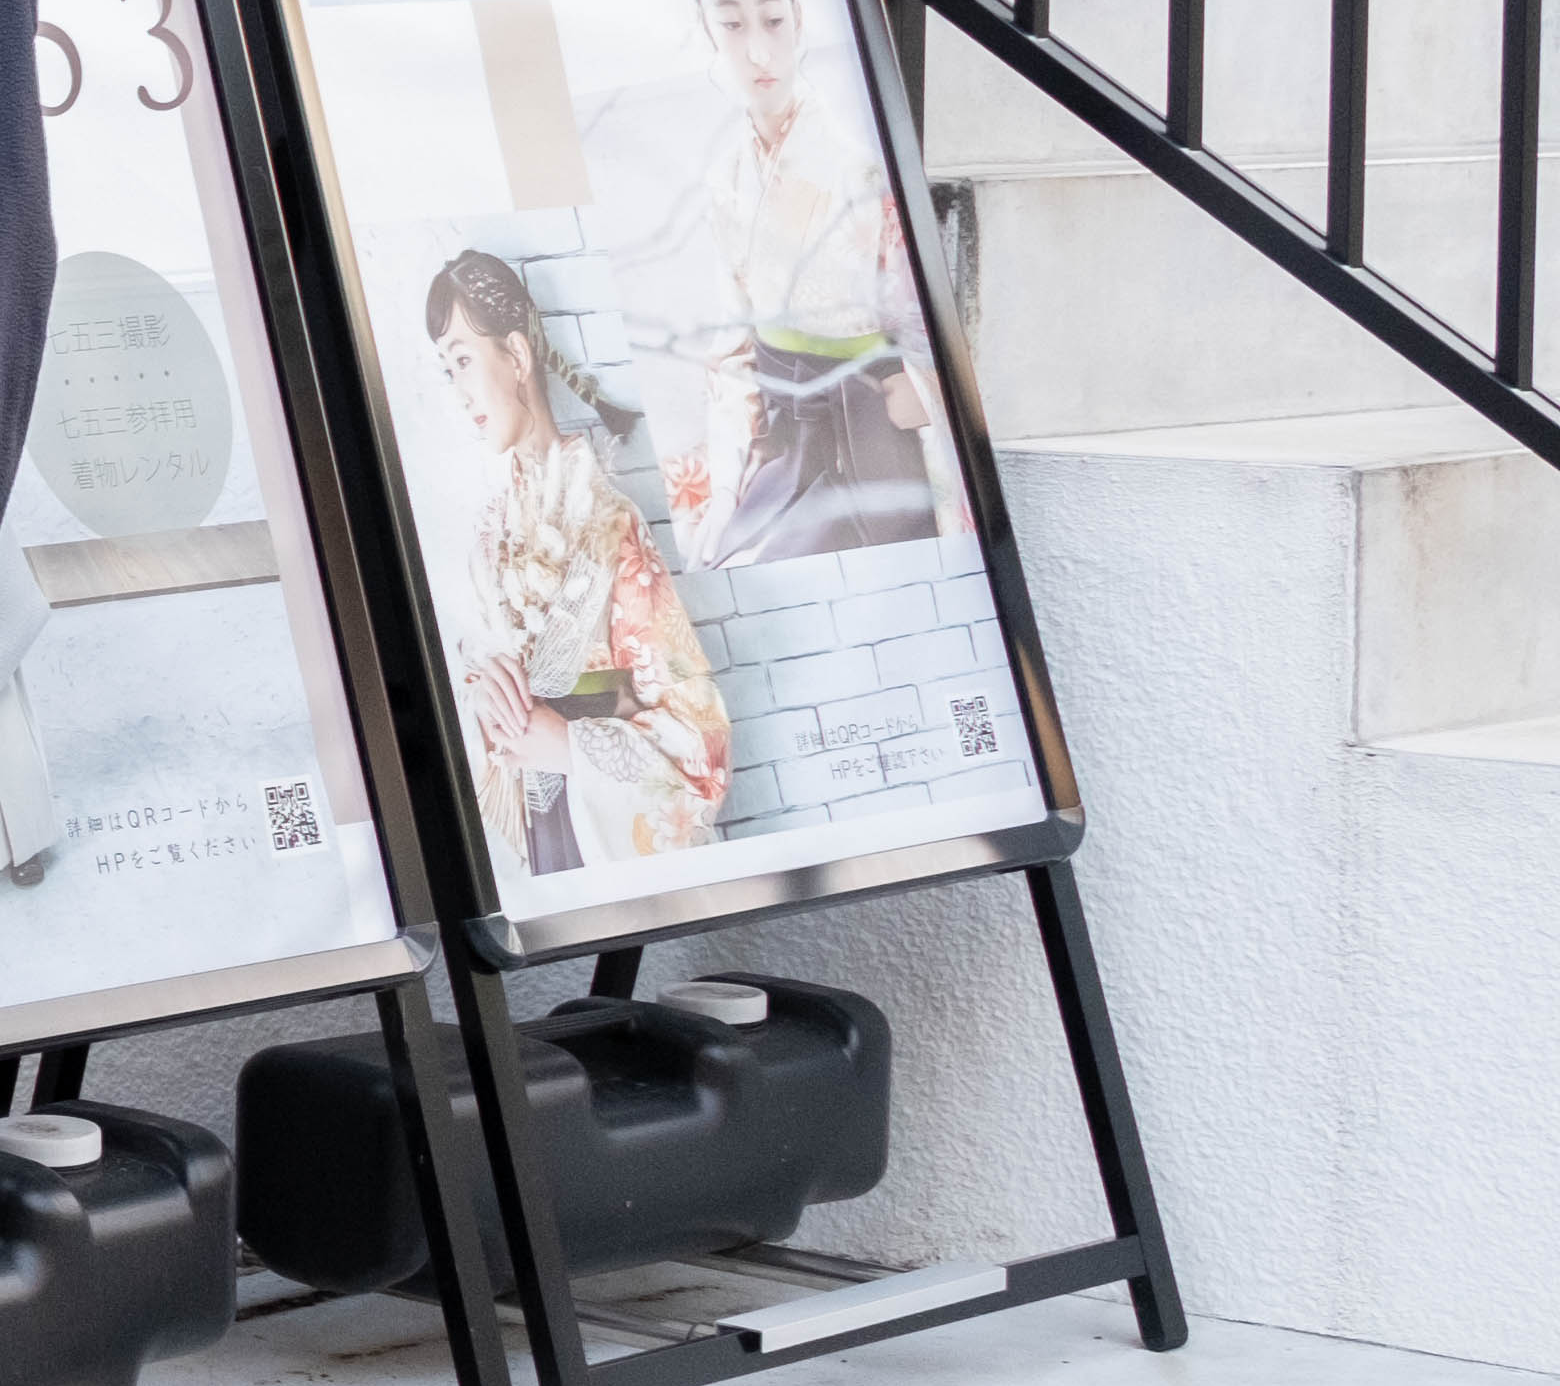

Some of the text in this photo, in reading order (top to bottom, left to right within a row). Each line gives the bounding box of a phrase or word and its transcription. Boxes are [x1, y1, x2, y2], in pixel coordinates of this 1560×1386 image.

[47, 314, 171, 355] 七五三撮影
[55, 398, 197, 440] 七五三参拝用
[71, 449, 209, 490] 着物レンタル
[65, 793, 249, 838] 詳細はQRコードから
[95, 835, 256, 875] HPをご覧ください
